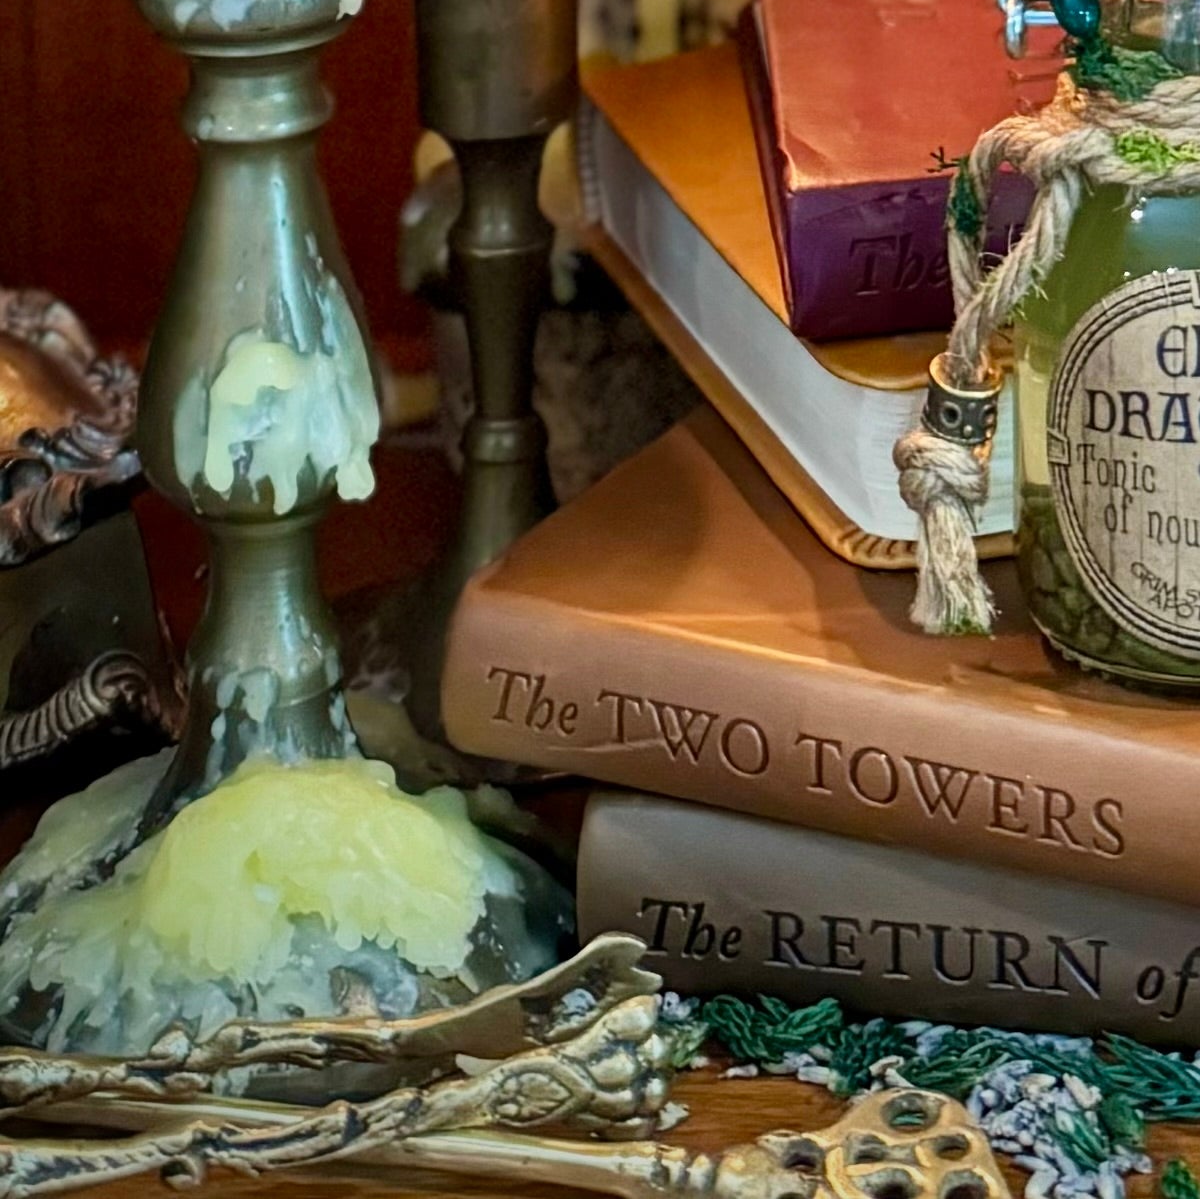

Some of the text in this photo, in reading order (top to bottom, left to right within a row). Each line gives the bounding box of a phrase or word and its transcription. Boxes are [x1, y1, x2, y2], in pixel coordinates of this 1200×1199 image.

[850, 232, 949, 296] The
[1076, 443, 1157, 493] Tonic
[1104, 493, 1133, 534] of
[1130, 561, 1178, 601] GRIM
[487, 666, 1128, 858] The TWO TOWERS
[641, 897, 743, 960] The
[762, 909, 1109, 999] RETURN
